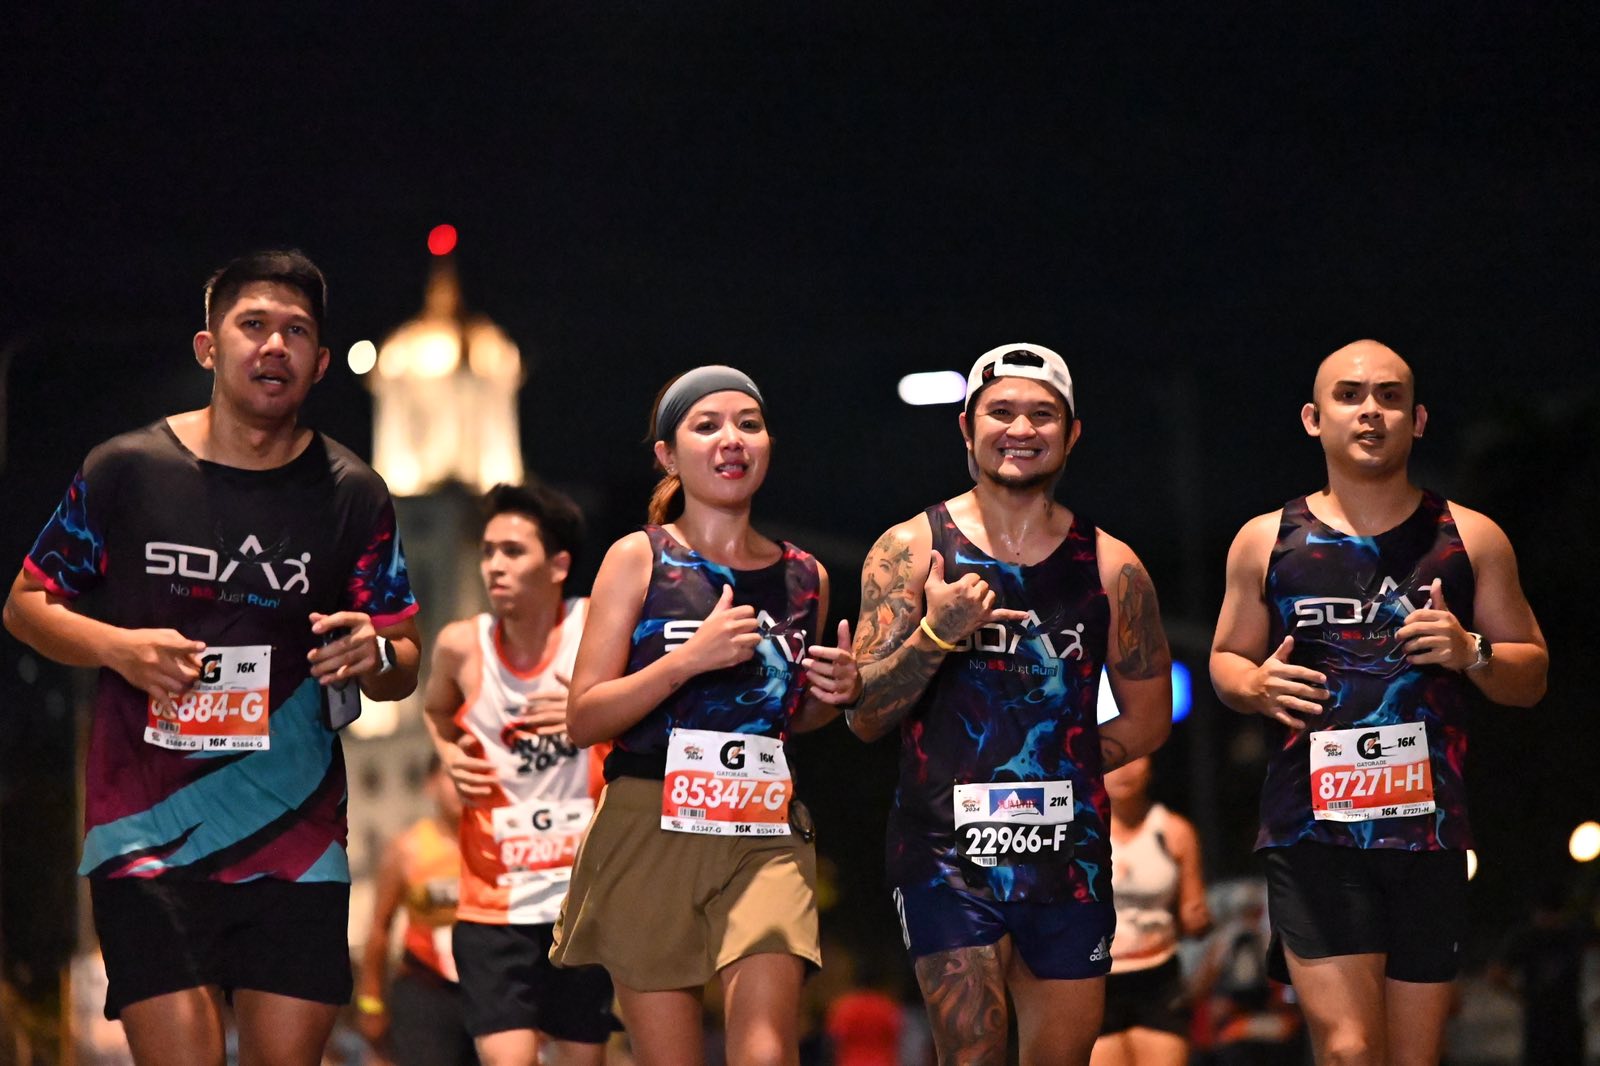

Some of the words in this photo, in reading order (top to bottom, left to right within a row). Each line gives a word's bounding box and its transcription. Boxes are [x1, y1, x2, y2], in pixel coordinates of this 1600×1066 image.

[170, 583, 190, 597] No
[218, 589, 245, 603] Just
[1322, 631, 1340, 640] No
[1368, 630, 1392, 640] Just
[236, 662, 257, 673] 16K
[969, 659, 987, 671] No
[1009, 662, 1030, 674] Just
[209, 738, 228, 748] 16K
[1356, 731, 1382, 760] G
[1397, 736, 1416, 748] 16K
[719, 740, 746, 770] G
[759, 752, 776, 764] 16K
[1356, 760, 1387, 768] GATORADE
[716, 770, 748, 778] GATORADE
[1319, 763, 1425, 800] 87271-H
[671, 775, 786, 811] 85347-G
[1049, 796, 1068, 807] 21K
[1381, 807, 1398, 816] 16K
[1402, 806, 1430, 815] 87271-H
[735, 825, 752, 833] 16K
[965, 824, 1068, 856] 22966-F
[501, 837, 581, 867] 87207-
